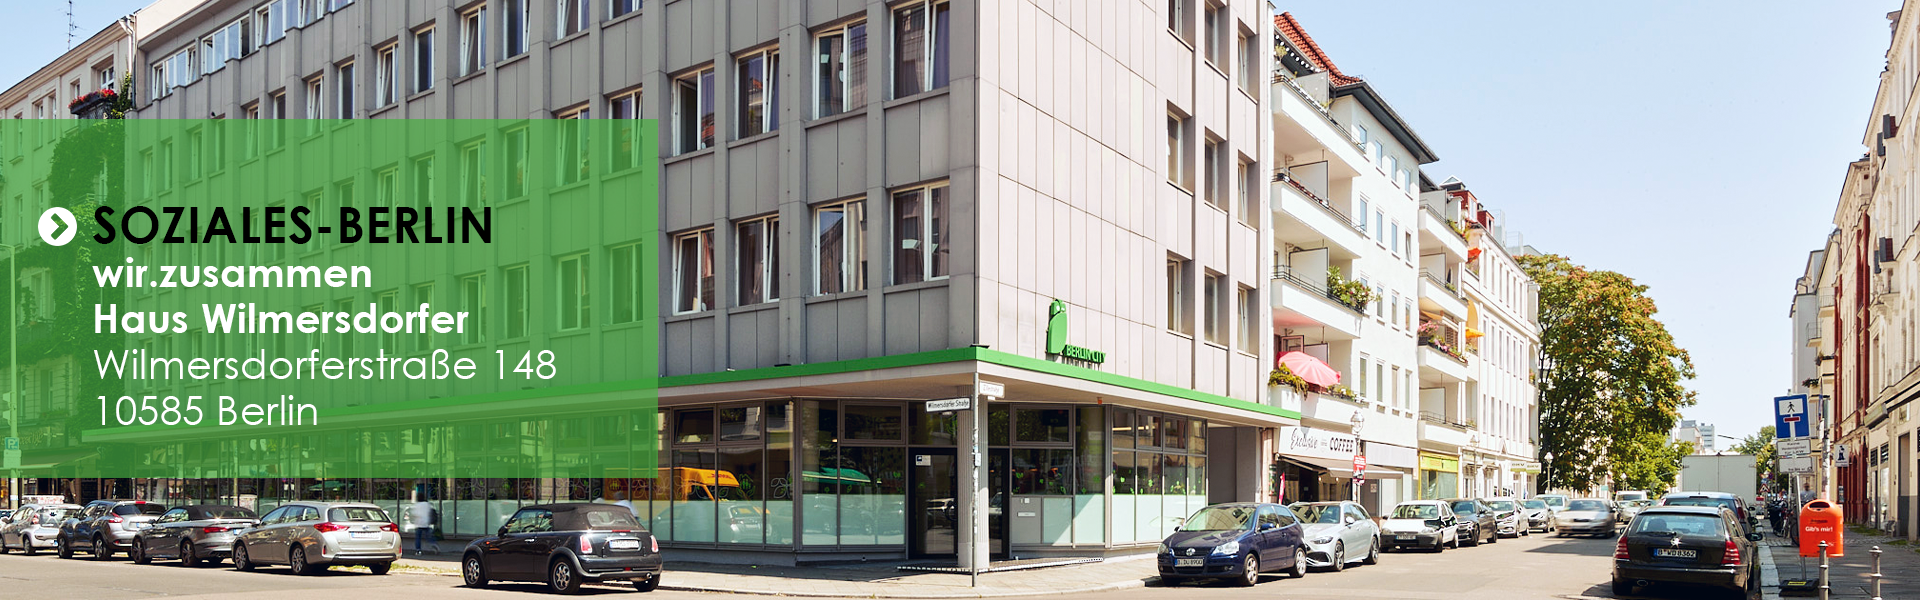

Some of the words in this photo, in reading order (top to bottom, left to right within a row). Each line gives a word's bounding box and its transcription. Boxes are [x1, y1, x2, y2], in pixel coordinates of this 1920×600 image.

[1065, 345, 1091, 360] BERLIN
[1091, 350, 1106, 363] CITY
[1329, 437, 1354, 452] COFFEE
